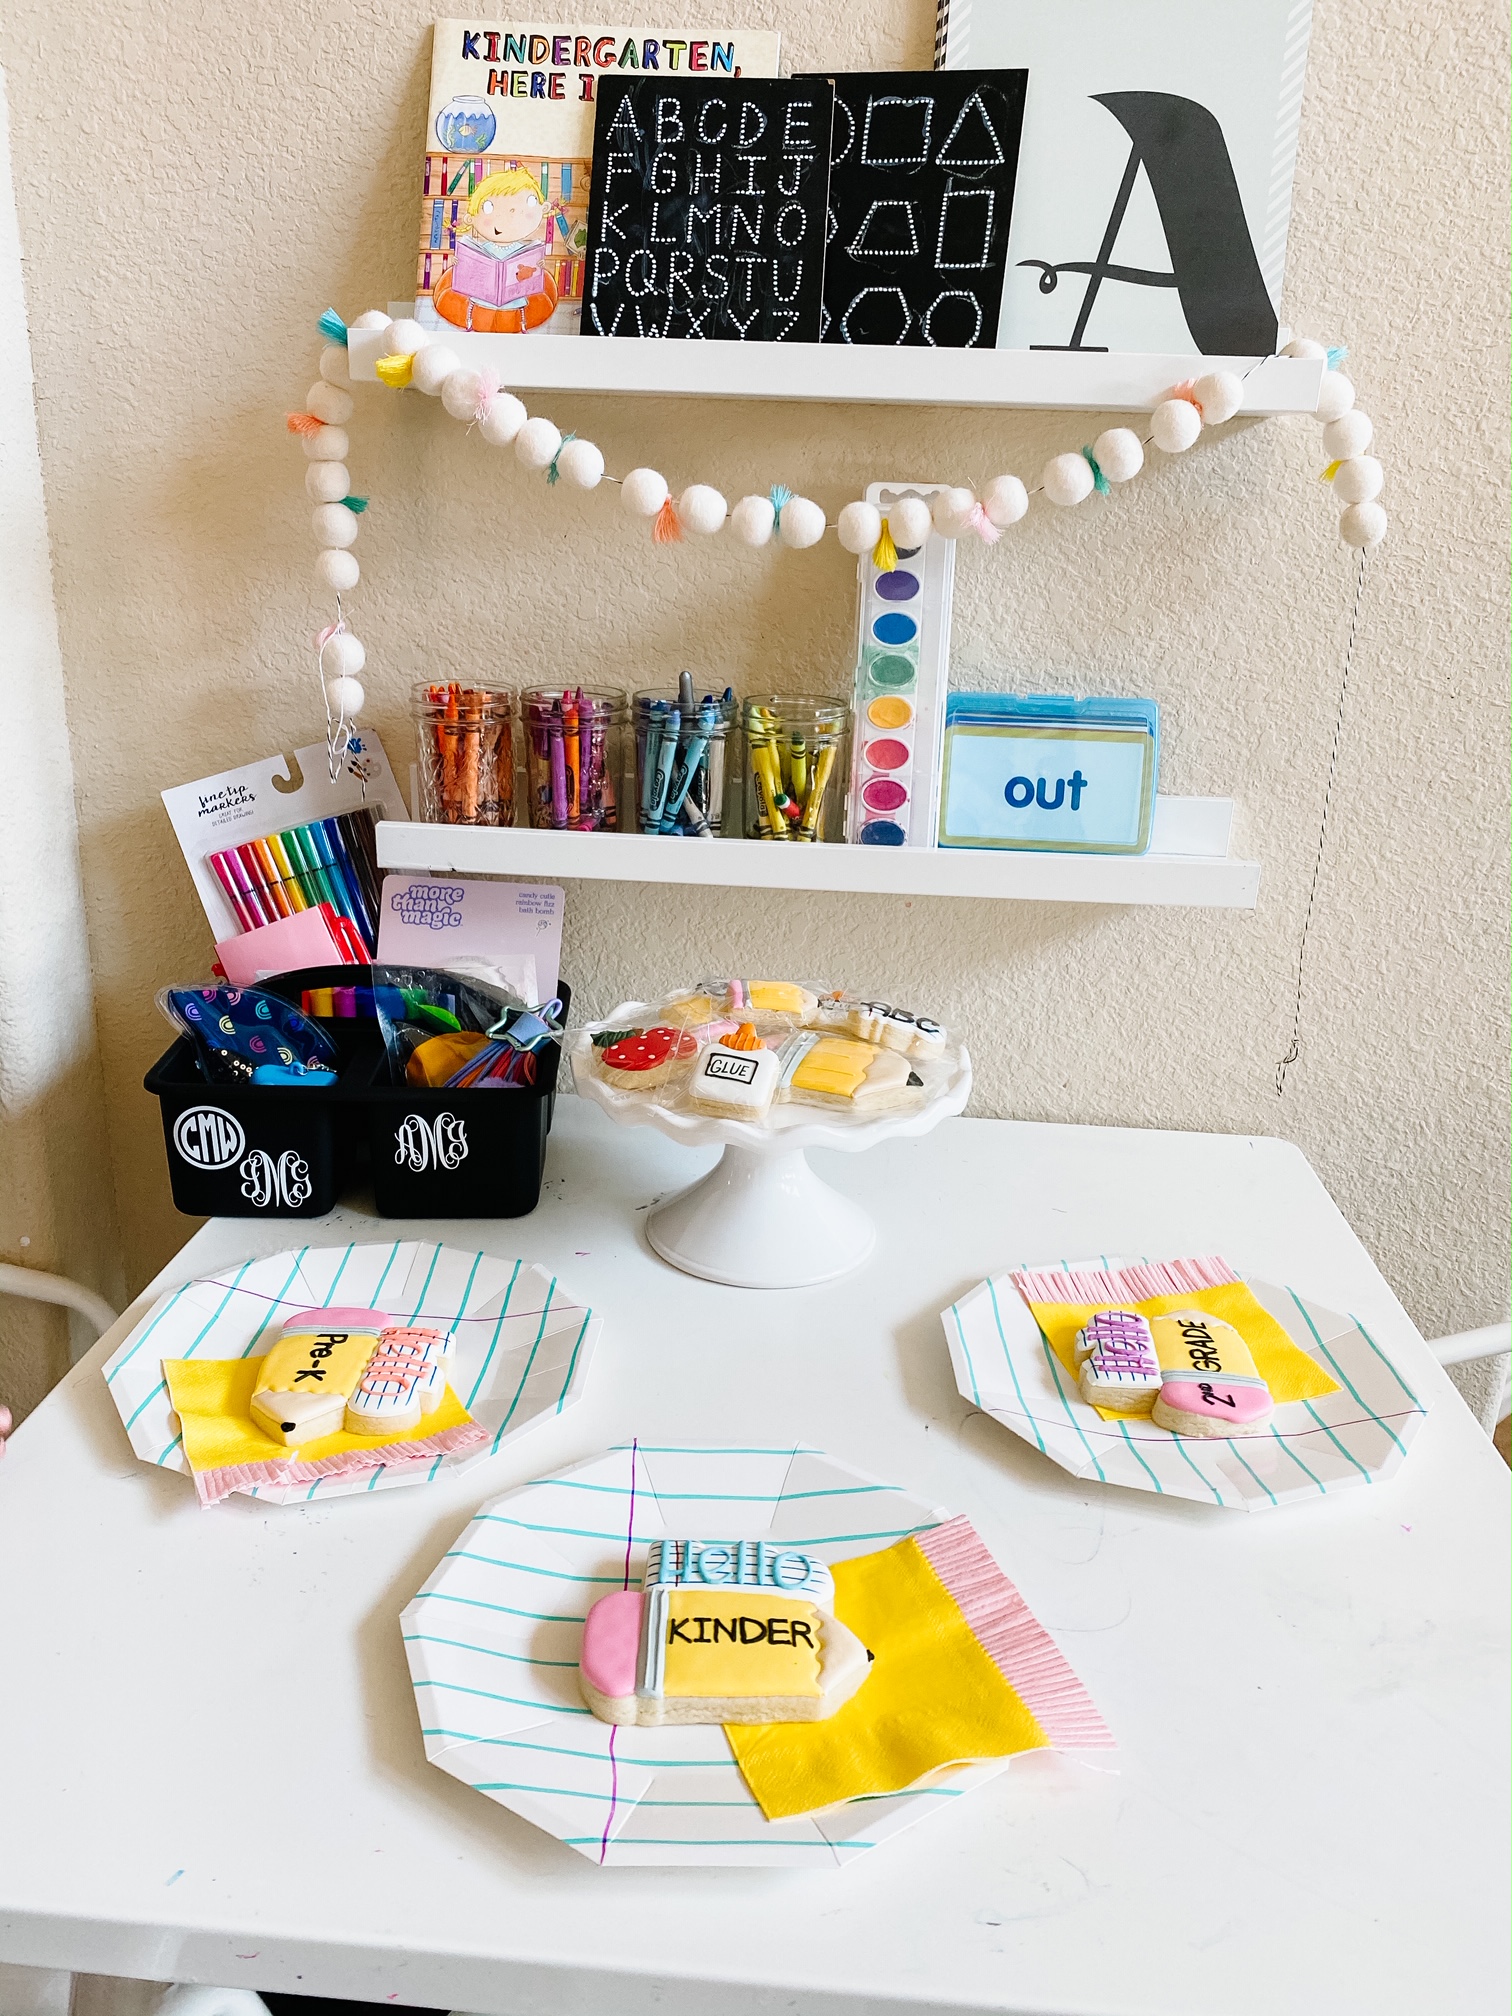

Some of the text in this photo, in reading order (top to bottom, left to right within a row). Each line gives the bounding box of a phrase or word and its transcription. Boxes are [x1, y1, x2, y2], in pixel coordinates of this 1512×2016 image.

[462, 30, 742, 78] KINDERGARTEN,
[486, 69, 567, 101] HERE
[605, 93, 814, 146] A B C D E
[604, 151, 814, 196] F G H I J
[600, 201, 808, 246] K L M N O
[1016, 90, 1279, 356] A
[592, 247, 803, 302] P Q R S T U
[197, 793, 258, 818] markers
[226, 785, 249, 797] tip
[1004, 769, 1088, 812] out
[391, 892, 440, 912] than
[409, 884, 465, 906] more
[401, 906, 463, 930] magic
[709, 1059, 751, 1078] GLUE
[1177, 1319, 1223, 1373] GRADE
[656, 1539, 812, 1591] Hello
[668, 1616, 815, 1650] KINDER
